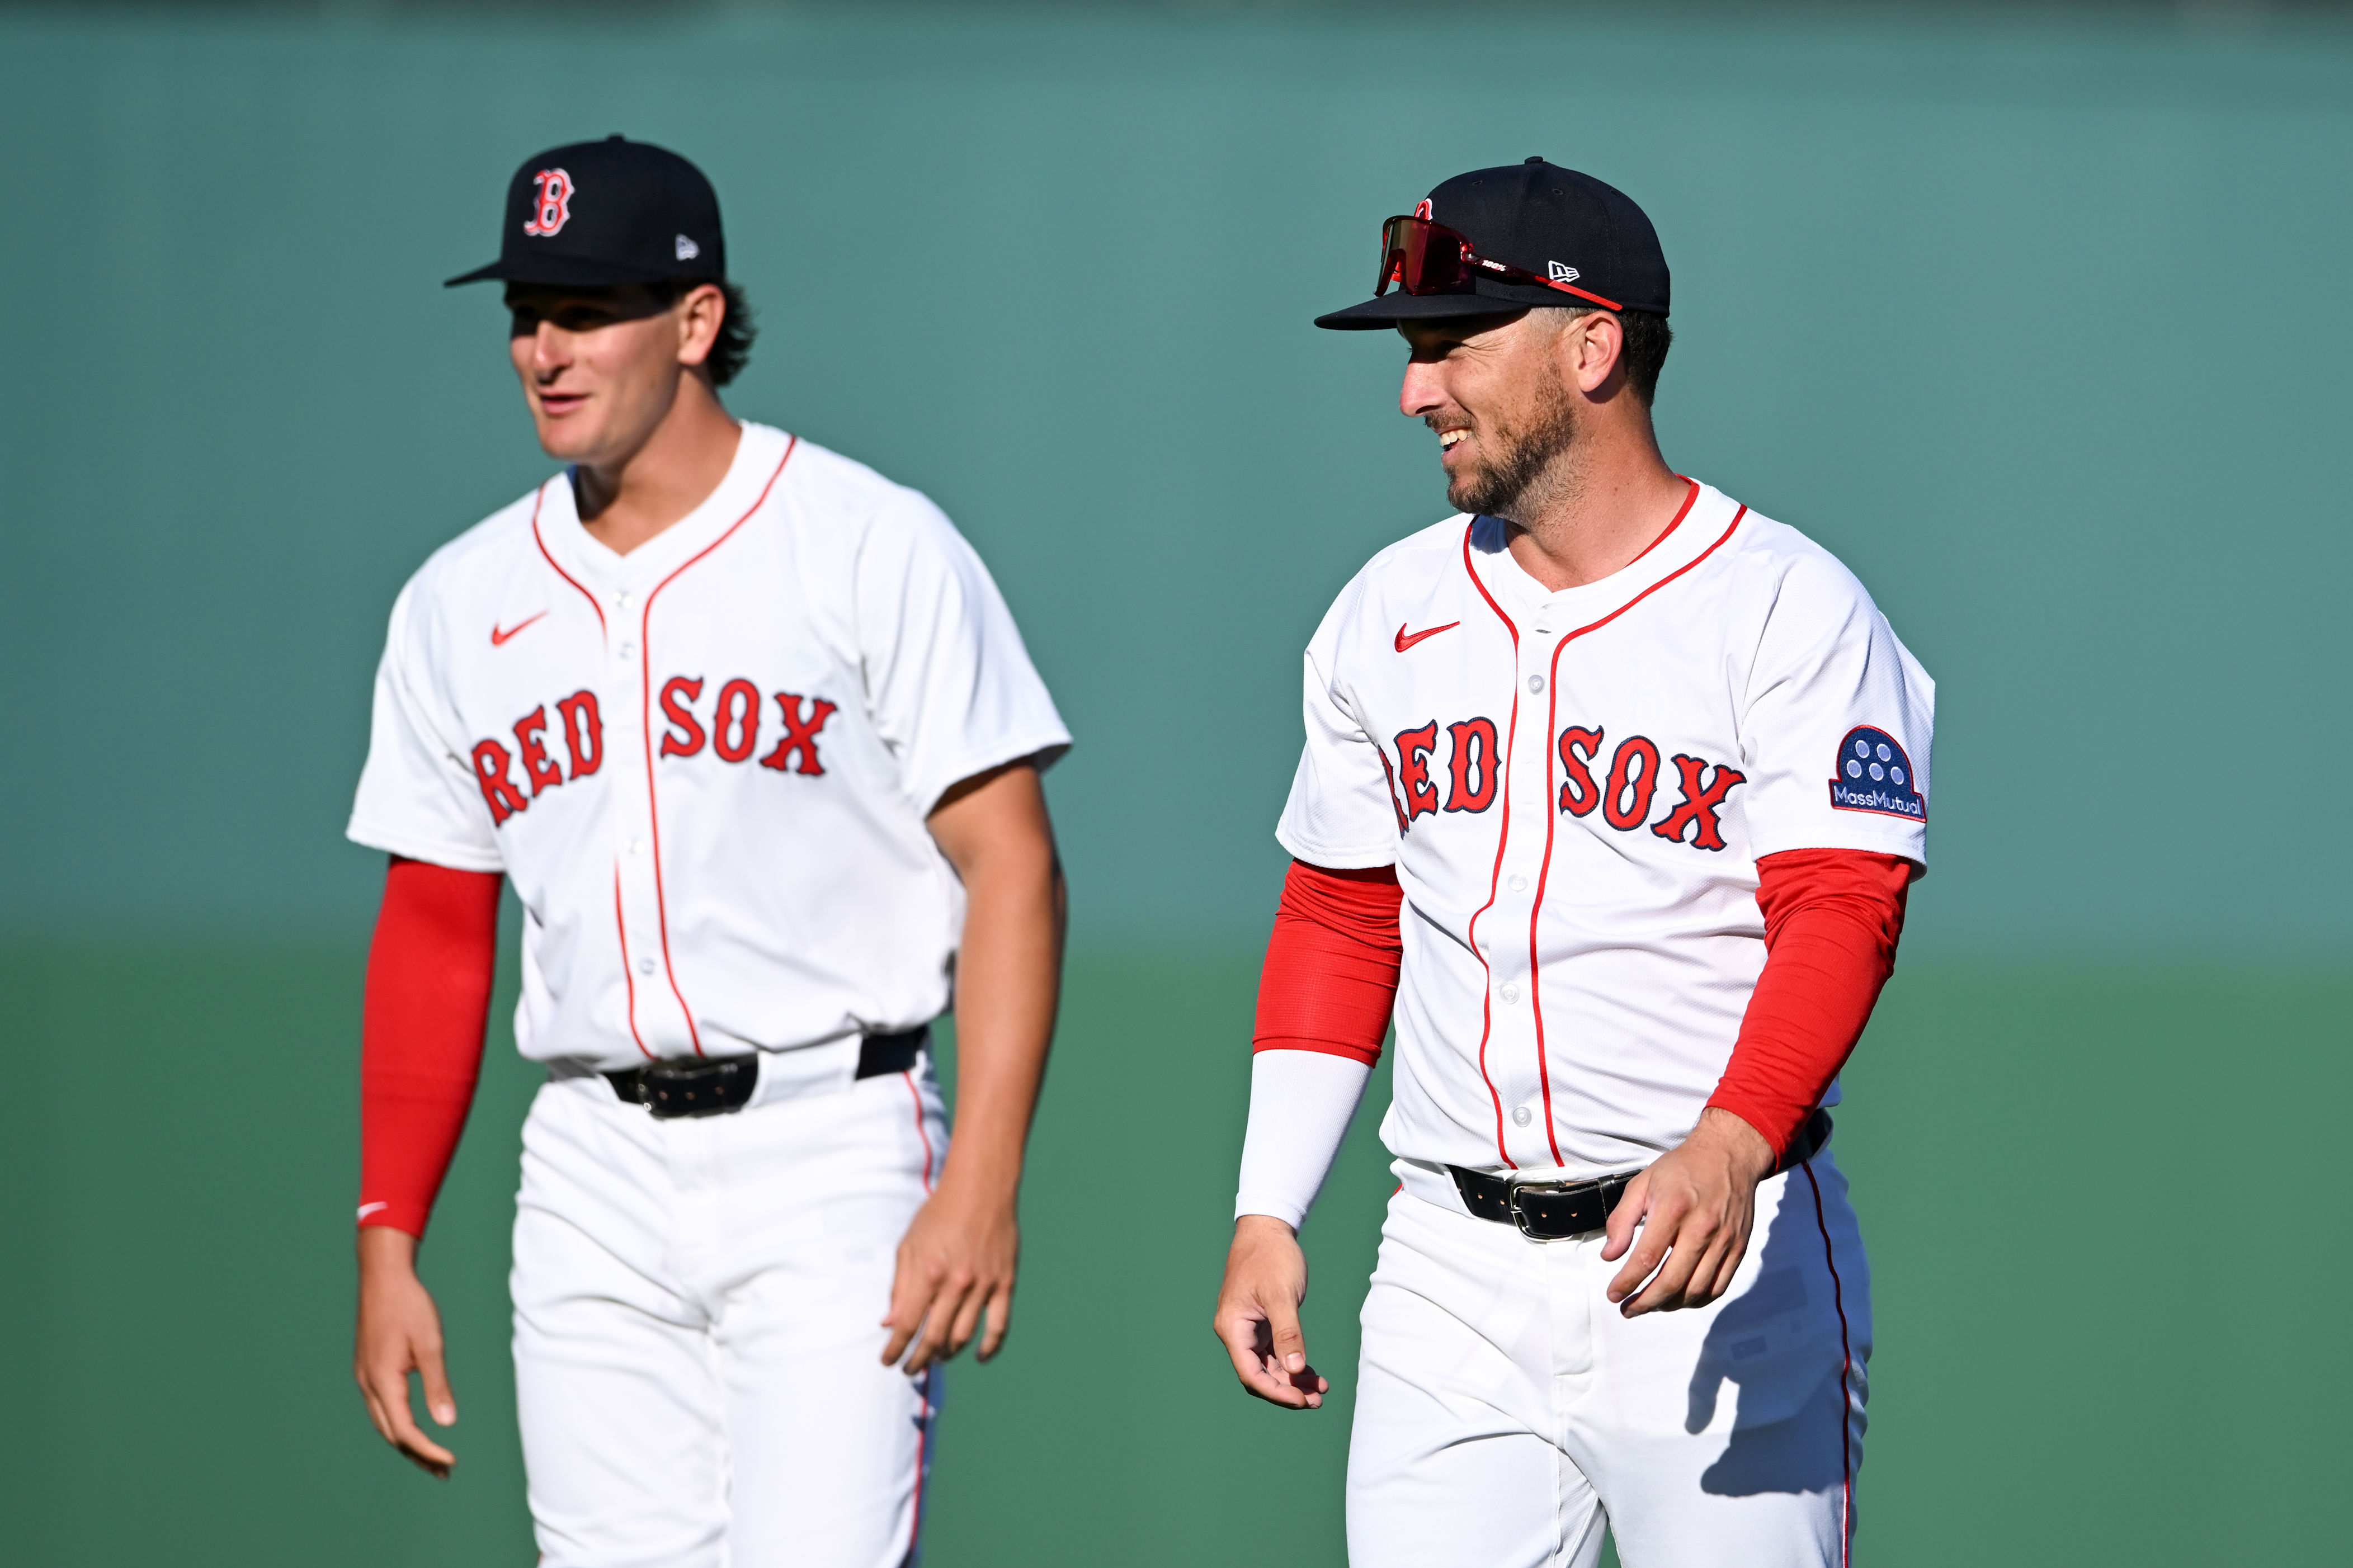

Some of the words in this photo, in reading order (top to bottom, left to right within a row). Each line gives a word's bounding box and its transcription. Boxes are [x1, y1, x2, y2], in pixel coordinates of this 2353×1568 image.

[523, 168, 575, 237] B
[1482, 259, 1507, 272] 100%
[471, 689, 603, 828] RED
[659, 676, 837, 777] SOX
[1378, 716, 1502, 839] ED
[1558, 725, 1747, 852] SOX
[1834, 785, 1921, 815] MassMutual
